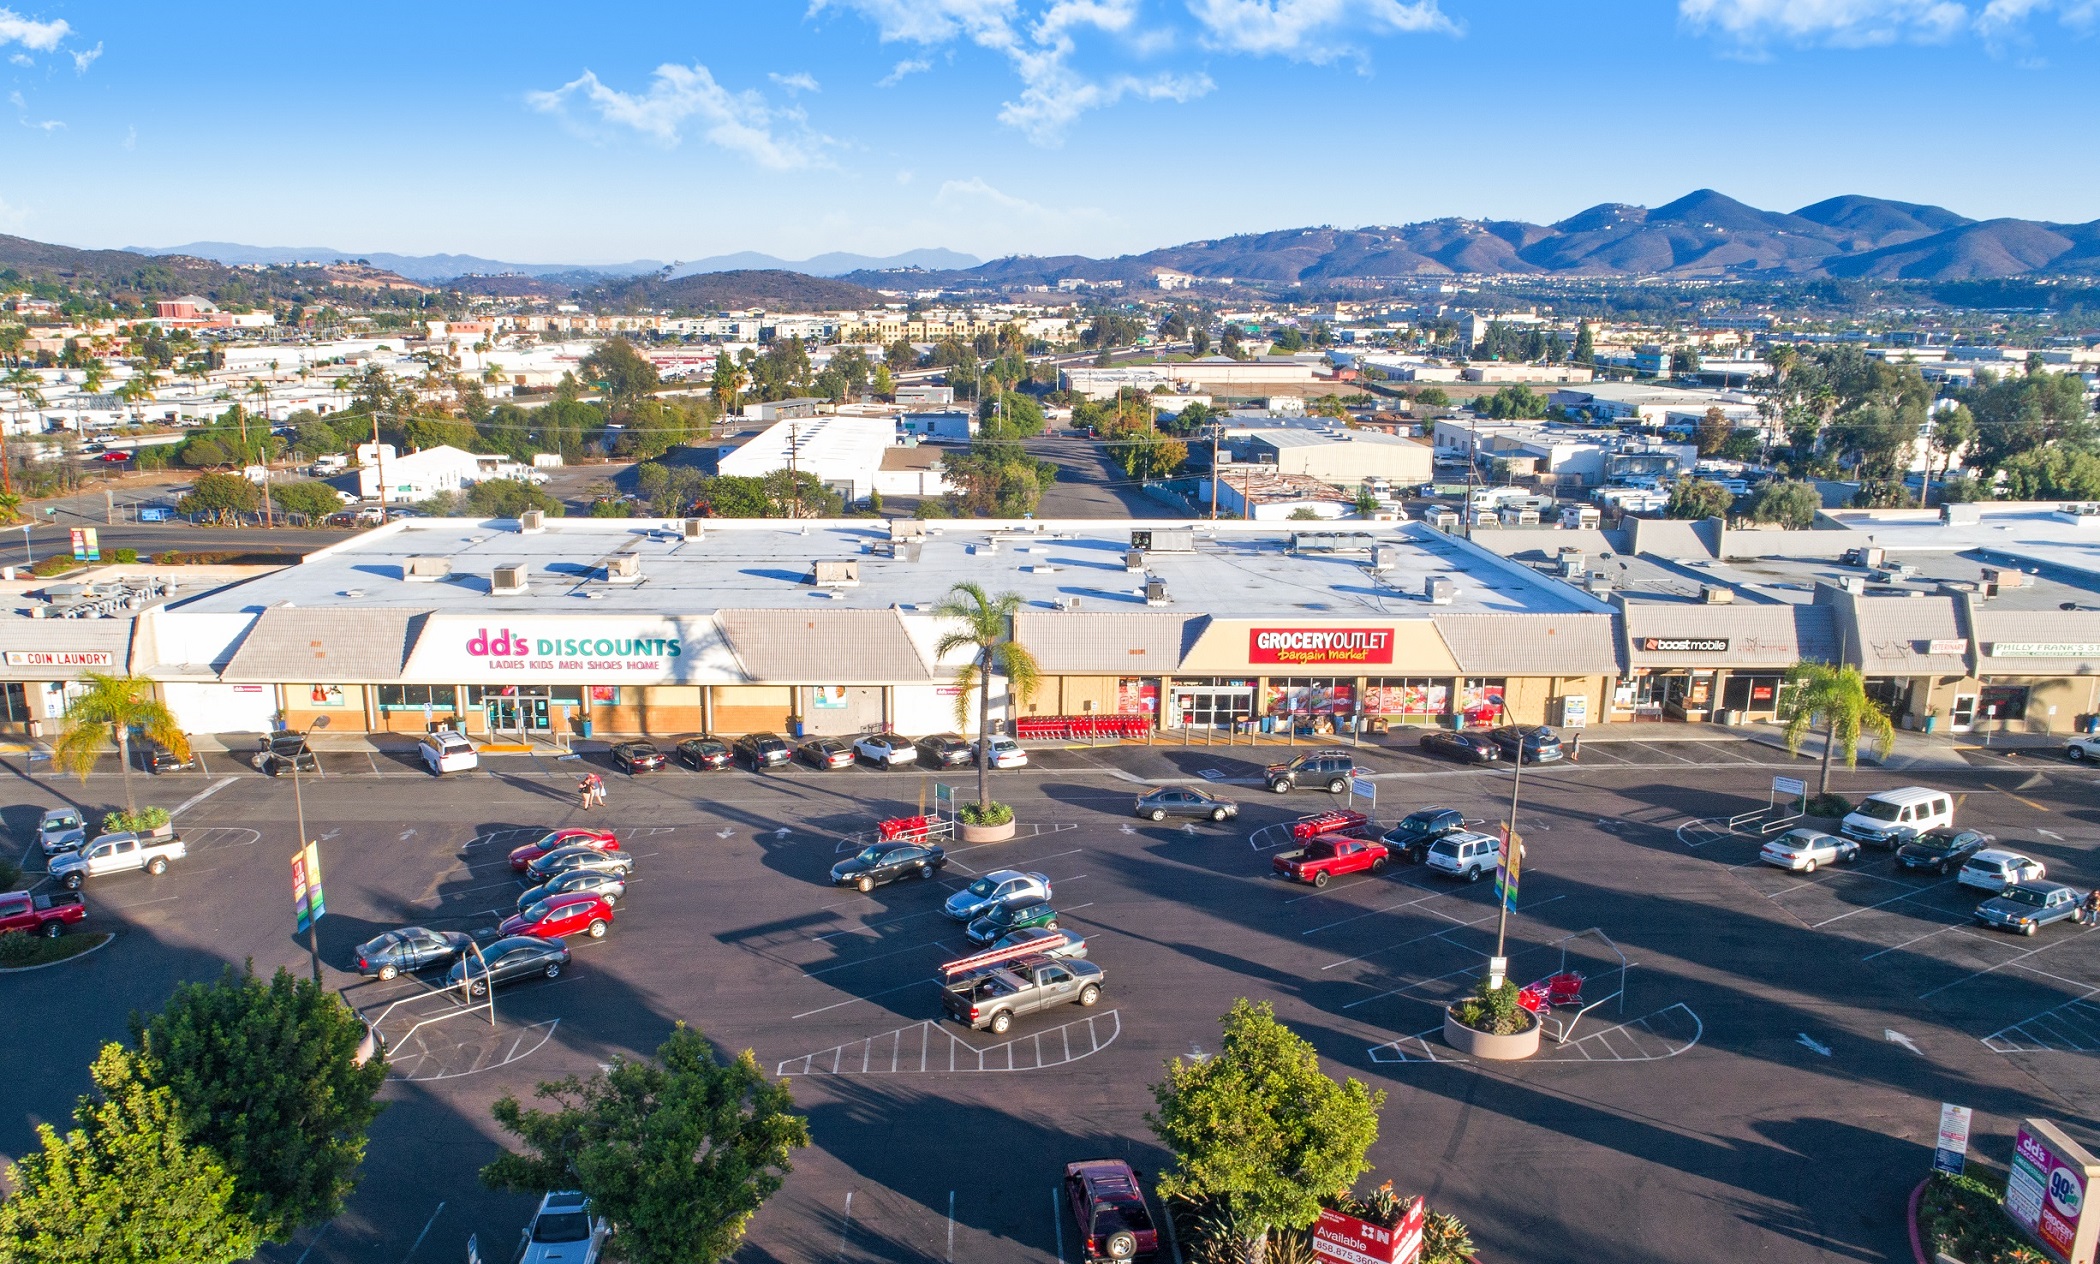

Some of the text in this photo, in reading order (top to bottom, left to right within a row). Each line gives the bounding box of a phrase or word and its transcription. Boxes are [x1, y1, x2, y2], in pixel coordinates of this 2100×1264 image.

[466, 628, 682, 657] dd's DISCOUNTS
[27, 653, 107, 665] COIN LAUNDRY
[489, 660, 659, 670] LADIES KIDS MEN SHOES HOME
[1277, 648, 1368, 665] bargain market
[2017, 1145, 2048, 1174] DISCOUNTS
[2023, 1138, 2046, 1161] dd's
[2042, 1209, 2075, 1240] GROCERY
[2045, 1219, 2068, 1246] OUTLET
[1317, 1226, 1367, 1251] Available
